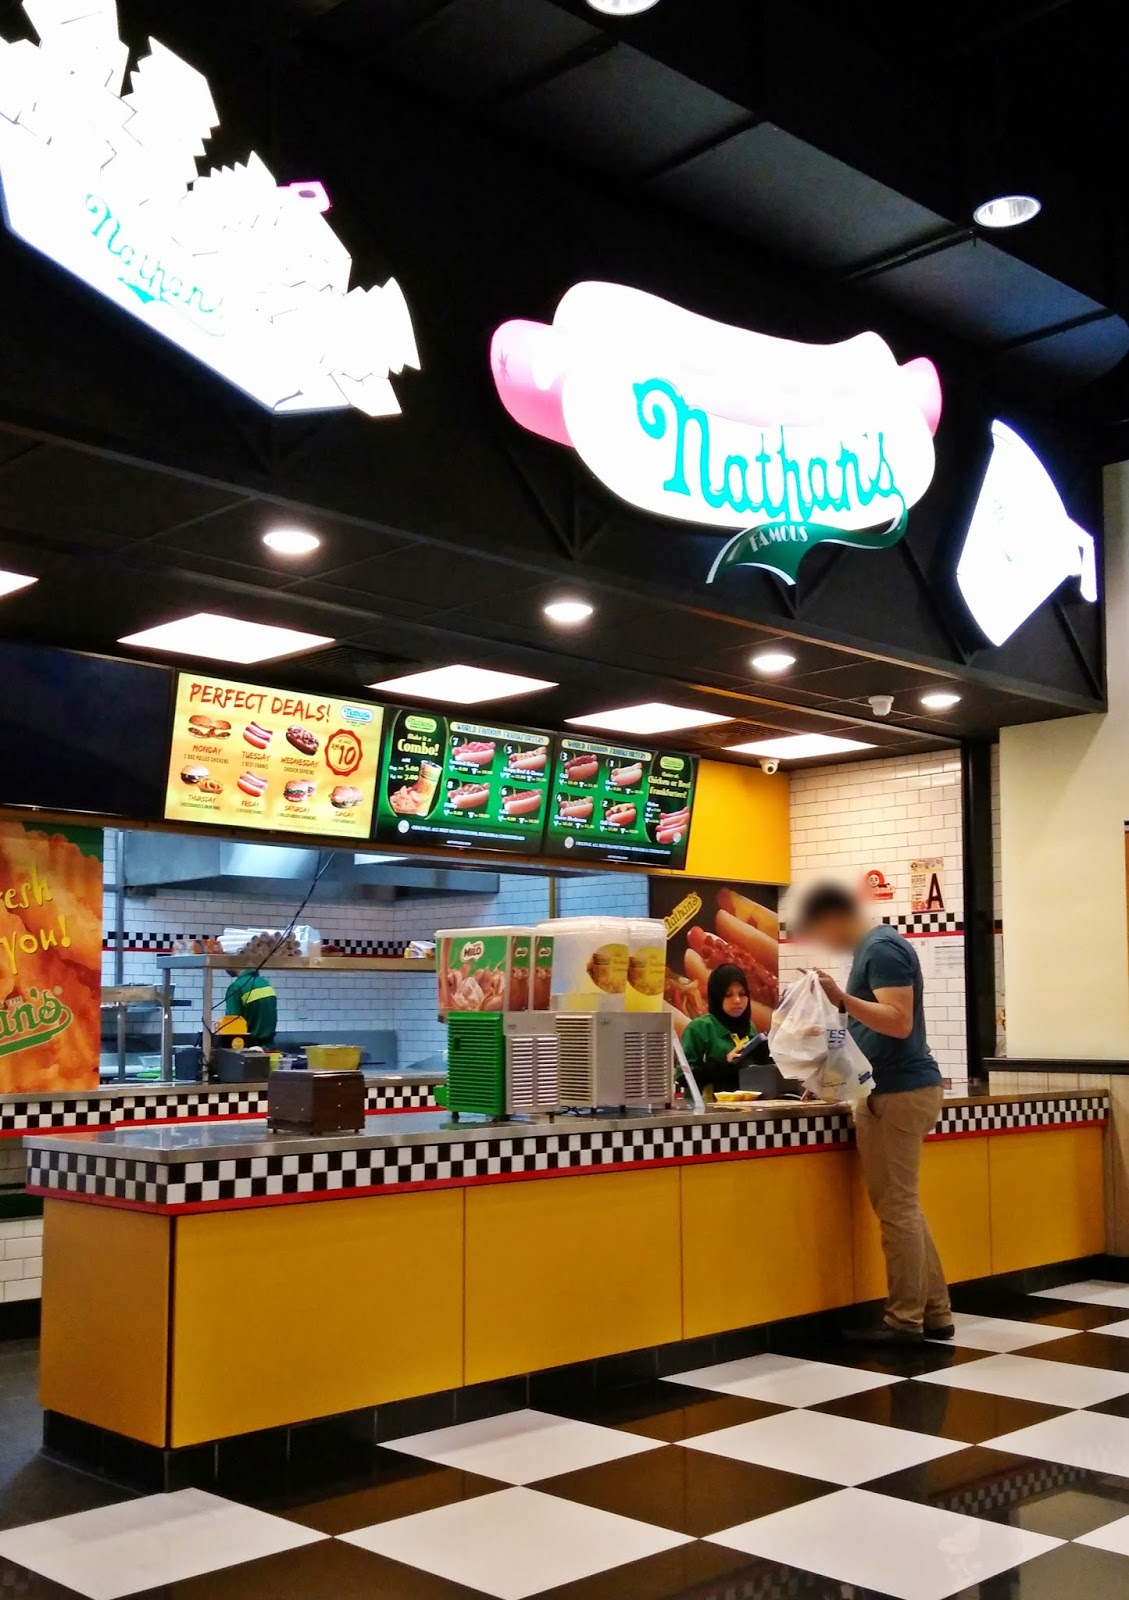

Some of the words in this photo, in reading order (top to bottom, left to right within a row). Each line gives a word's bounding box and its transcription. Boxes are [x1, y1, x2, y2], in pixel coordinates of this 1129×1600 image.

[632, 377, 896, 523] Nathan's
[748, 524, 808, 552] FAMOUS
[189, 682, 268, 713] PERFECT
[271, 696, 331, 723] DEALS!
[397, 738, 440, 756] Combo!
[452, 737, 459, 746] 7
[192, 744, 223, 755] MONDAY
[338, 745, 356, 765] 10
[506, 745, 513, 754] 5
[241, 750, 271, 762] TUESDAY
[561, 752, 568, 761] 3
[280, 756, 320, 768] WEDNESDAY
[446, 780, 454, 790] 8
[500, 787, 508, 796] 6
[188, 794, 217, 803] THURSDAY
[556, 793, 563, 802] 4
[241, 800, 260, 808] FRIDAY
[602, 800, 609, 808] 2
[0, 864, 53, 909] esh
[927, 873, 944, 909] A
[0, 915, 72, 975] you!
[464, 946, 482, 957] MILO
[826, 1028, 846, 1039] ES
